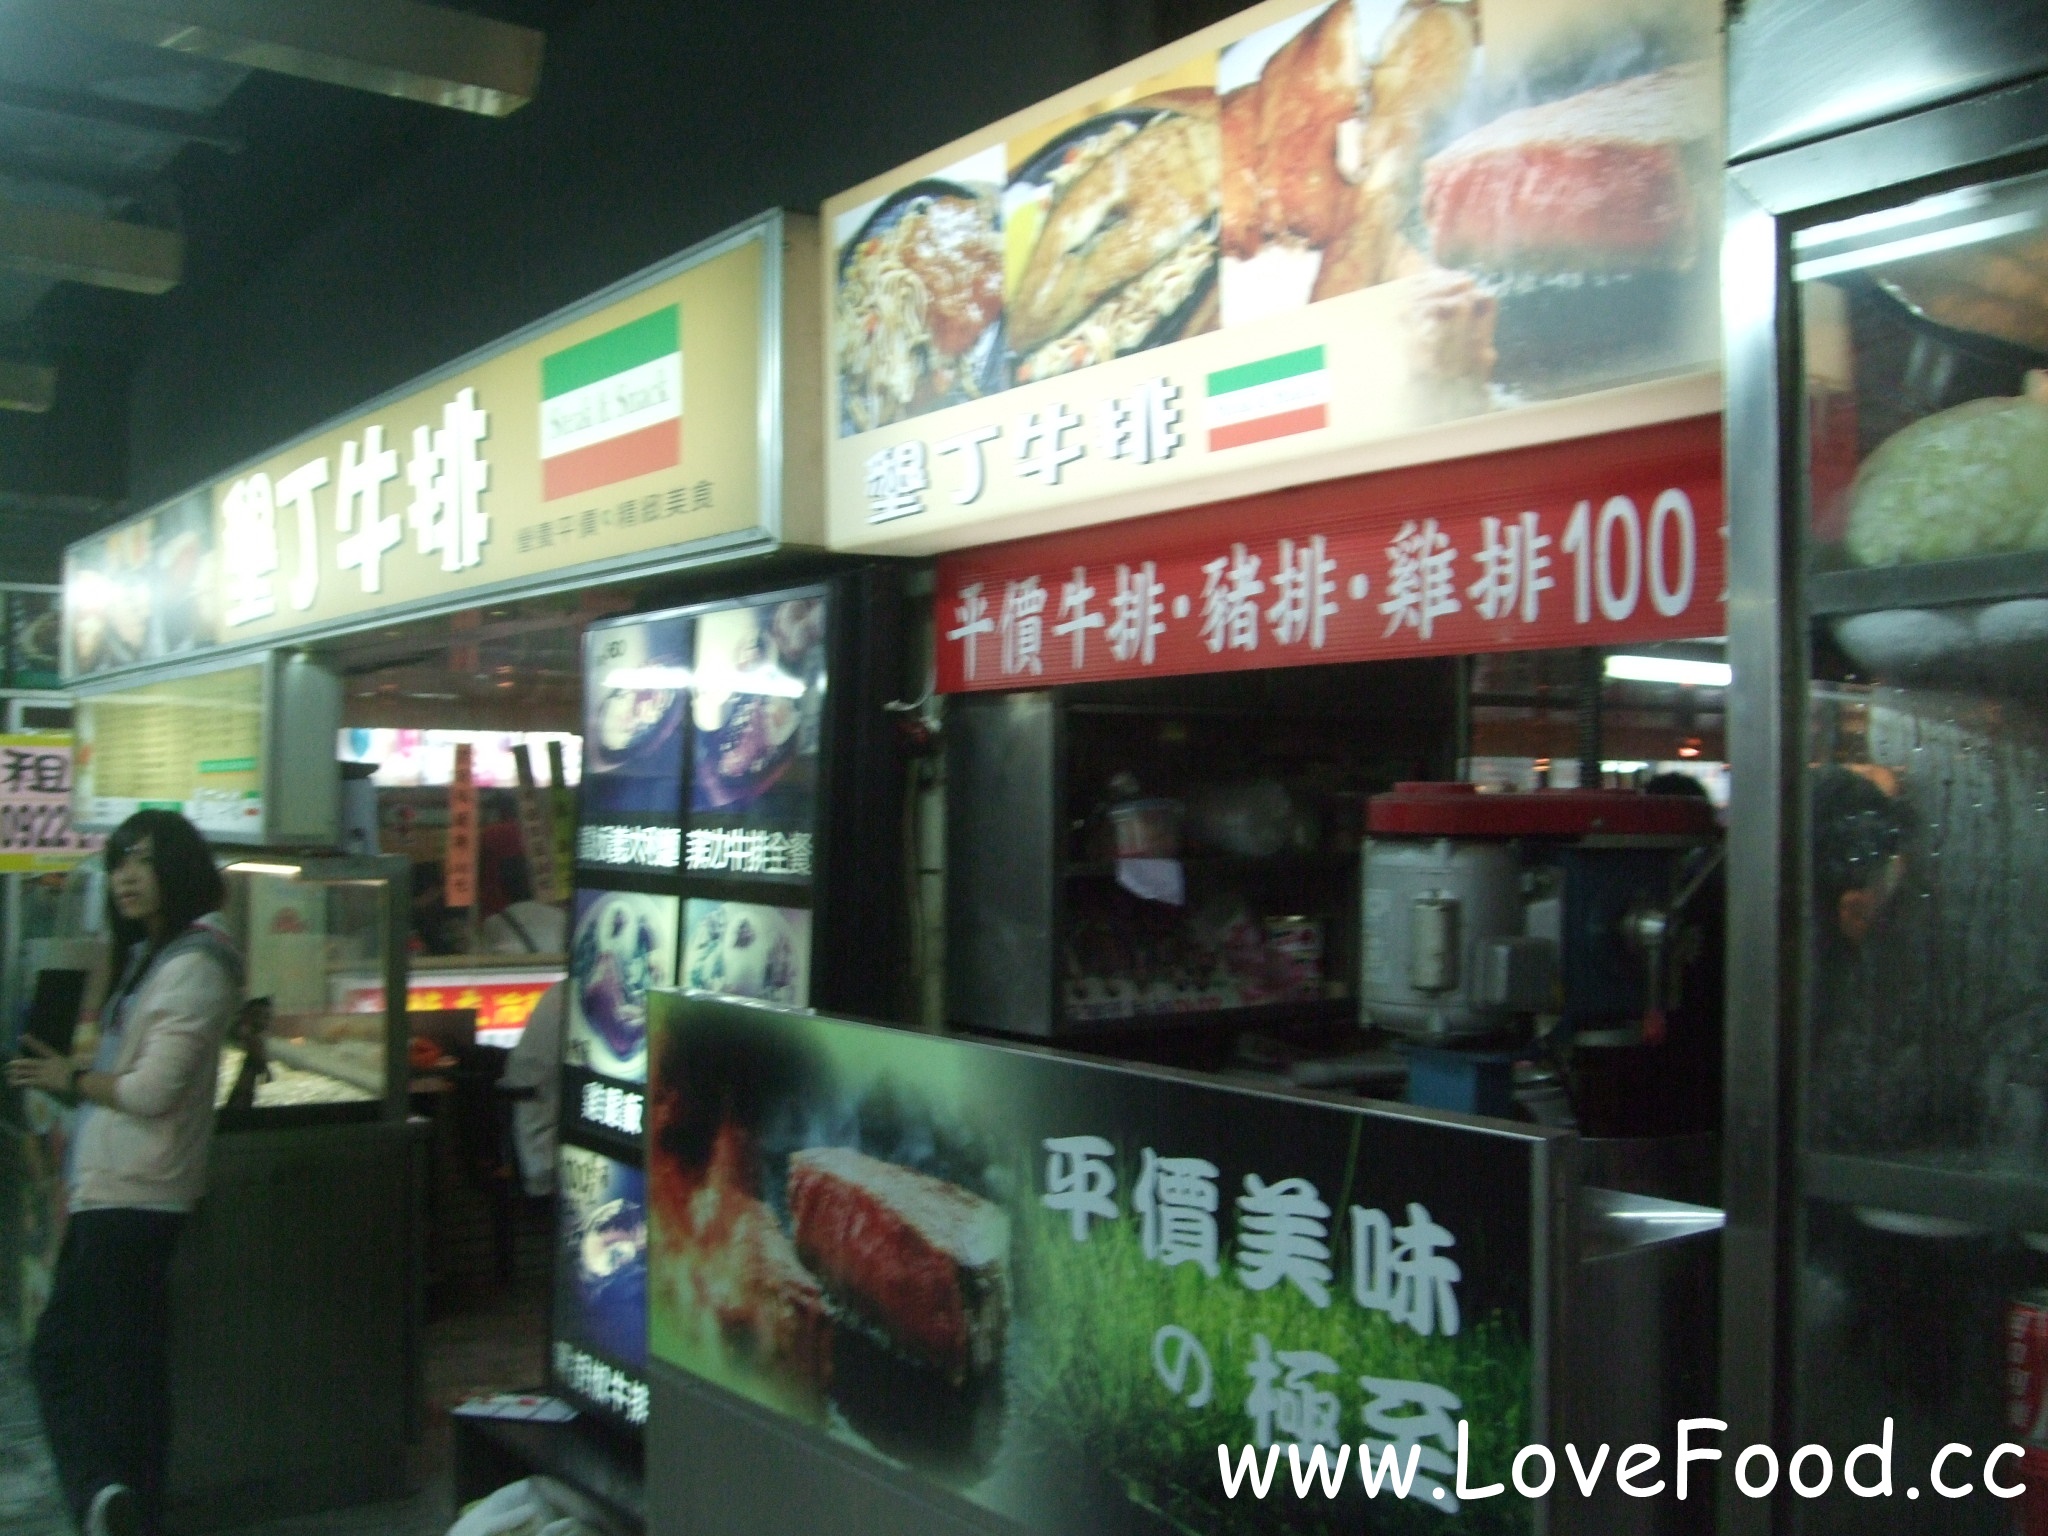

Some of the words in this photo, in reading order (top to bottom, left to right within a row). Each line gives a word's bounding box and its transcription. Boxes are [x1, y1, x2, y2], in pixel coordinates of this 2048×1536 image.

[220, 387, 489, 627] 墾丁牛排
[866, 375, 1185, 525] 墾丁牛排
[1041, 1135, 1463, 1337] 平價美味
